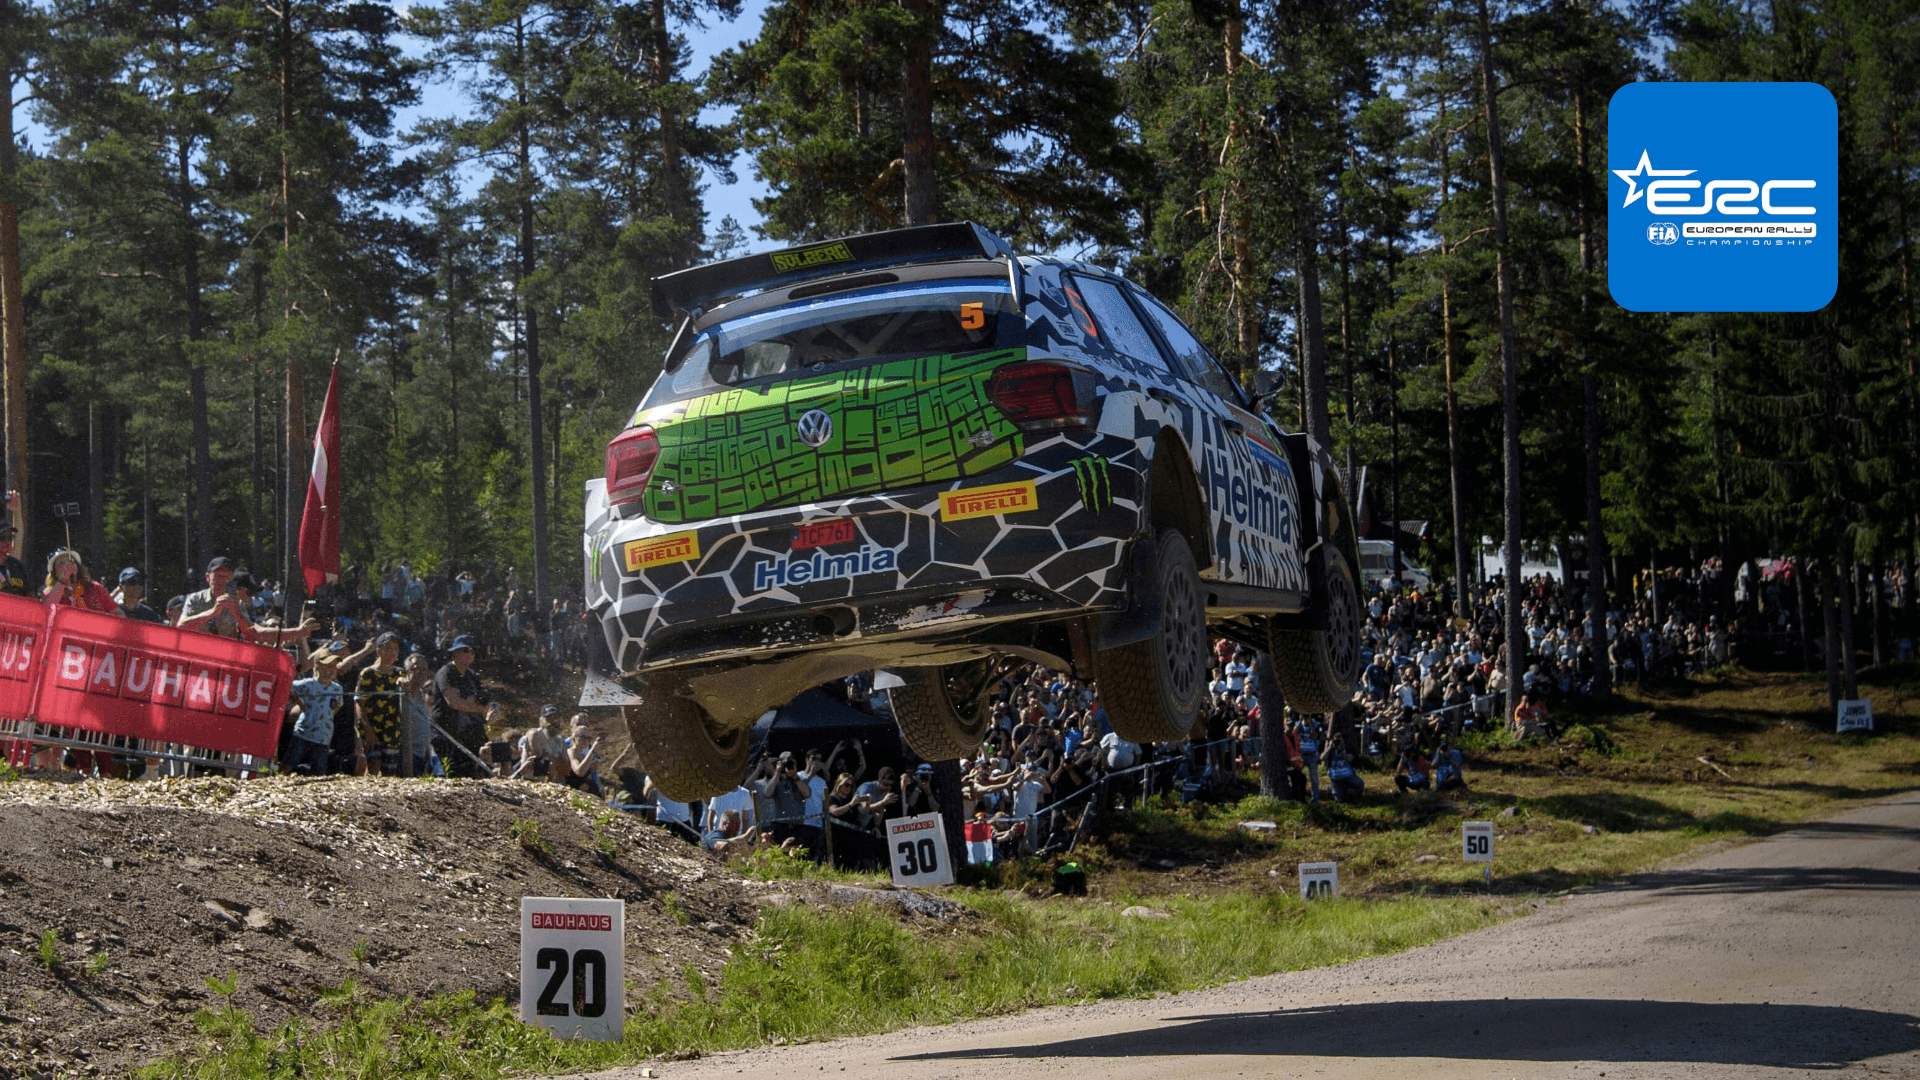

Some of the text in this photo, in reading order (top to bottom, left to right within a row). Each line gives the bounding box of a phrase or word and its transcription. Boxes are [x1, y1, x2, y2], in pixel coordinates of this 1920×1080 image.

[773, 243, 850, 271] SOLBERG
[960, 302, 985, 330] 5
[1064, 286, 1098, 337] 5
[947, 487, 1028, 515] PIRELLI
[1207, 447, 1292, 545] Helmia
[630, 537, 692, 565] PIRELLI
[755, 545, 897, 590] Helmia
[60, 645, 274, 712] BAUHAUS
[898, 838, 938, 876] 30
[1467, 835, 1489, 855] 50
[533, 914, 611, 929] BAUHAUS
[536, 947, 607, 1018] 20
